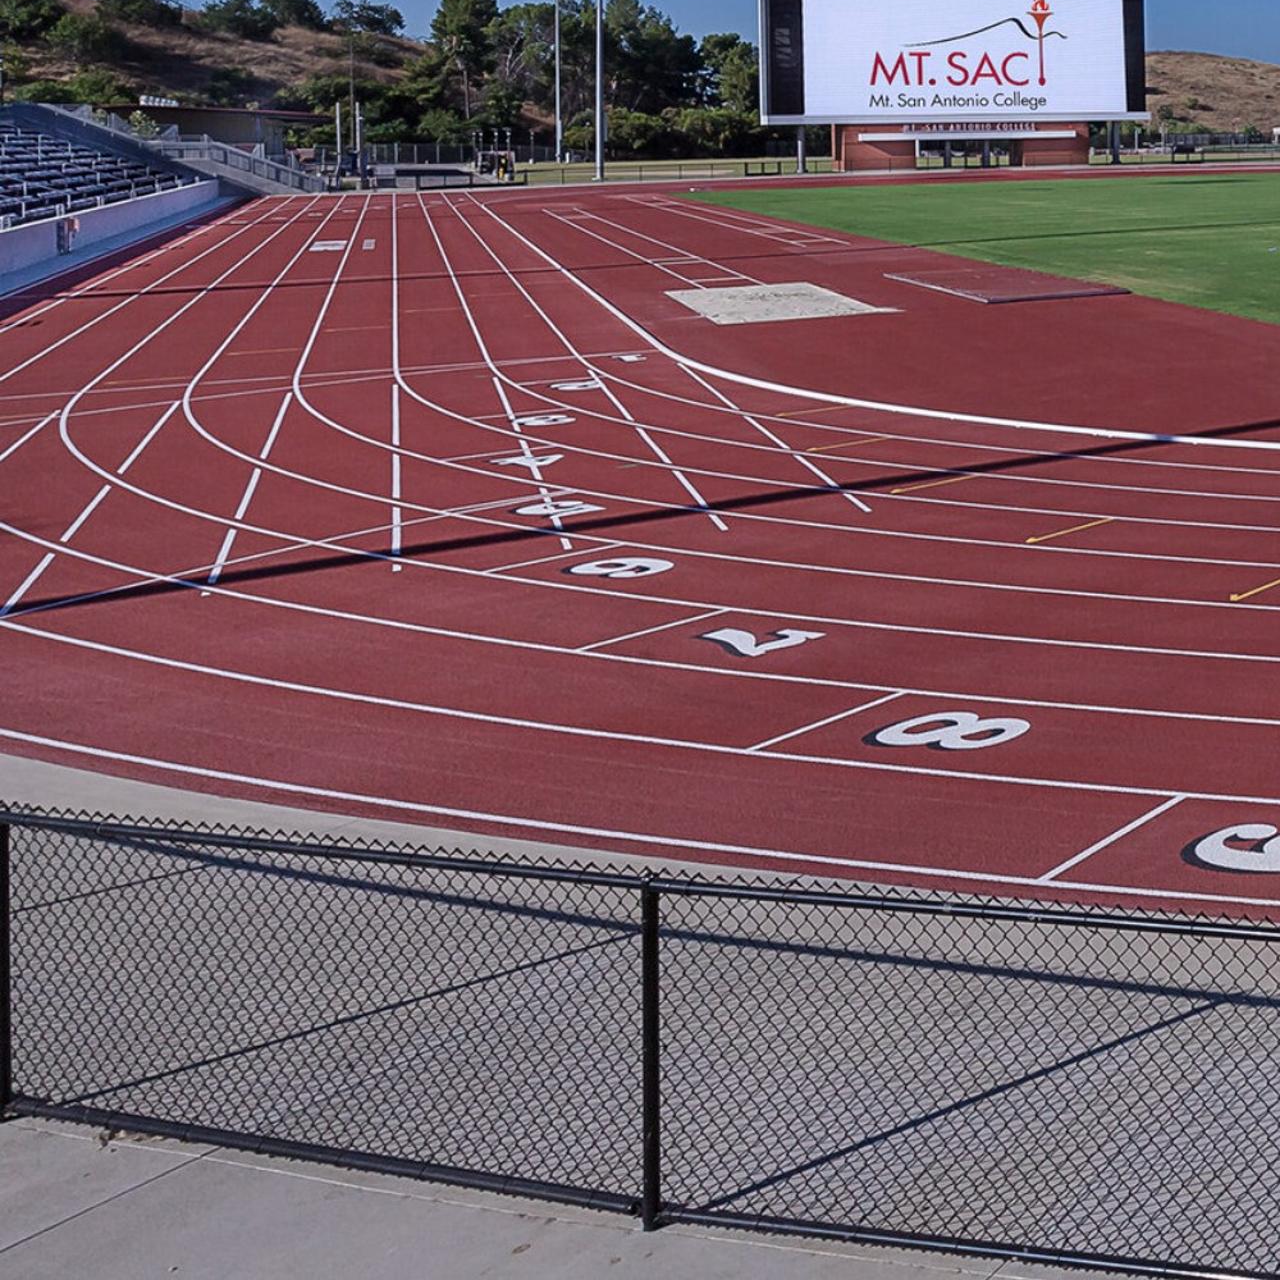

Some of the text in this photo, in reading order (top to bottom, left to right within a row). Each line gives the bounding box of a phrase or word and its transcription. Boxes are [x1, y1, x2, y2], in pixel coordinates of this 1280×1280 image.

[870, 51, 1030, 86] MT. SAC
[869, 91, 1047, 110] Mt. San Antonio College
[569, 556, 675, 579] 6
[702, 627, 827, 657] 7
[874, 711, 1031, 750] 8
